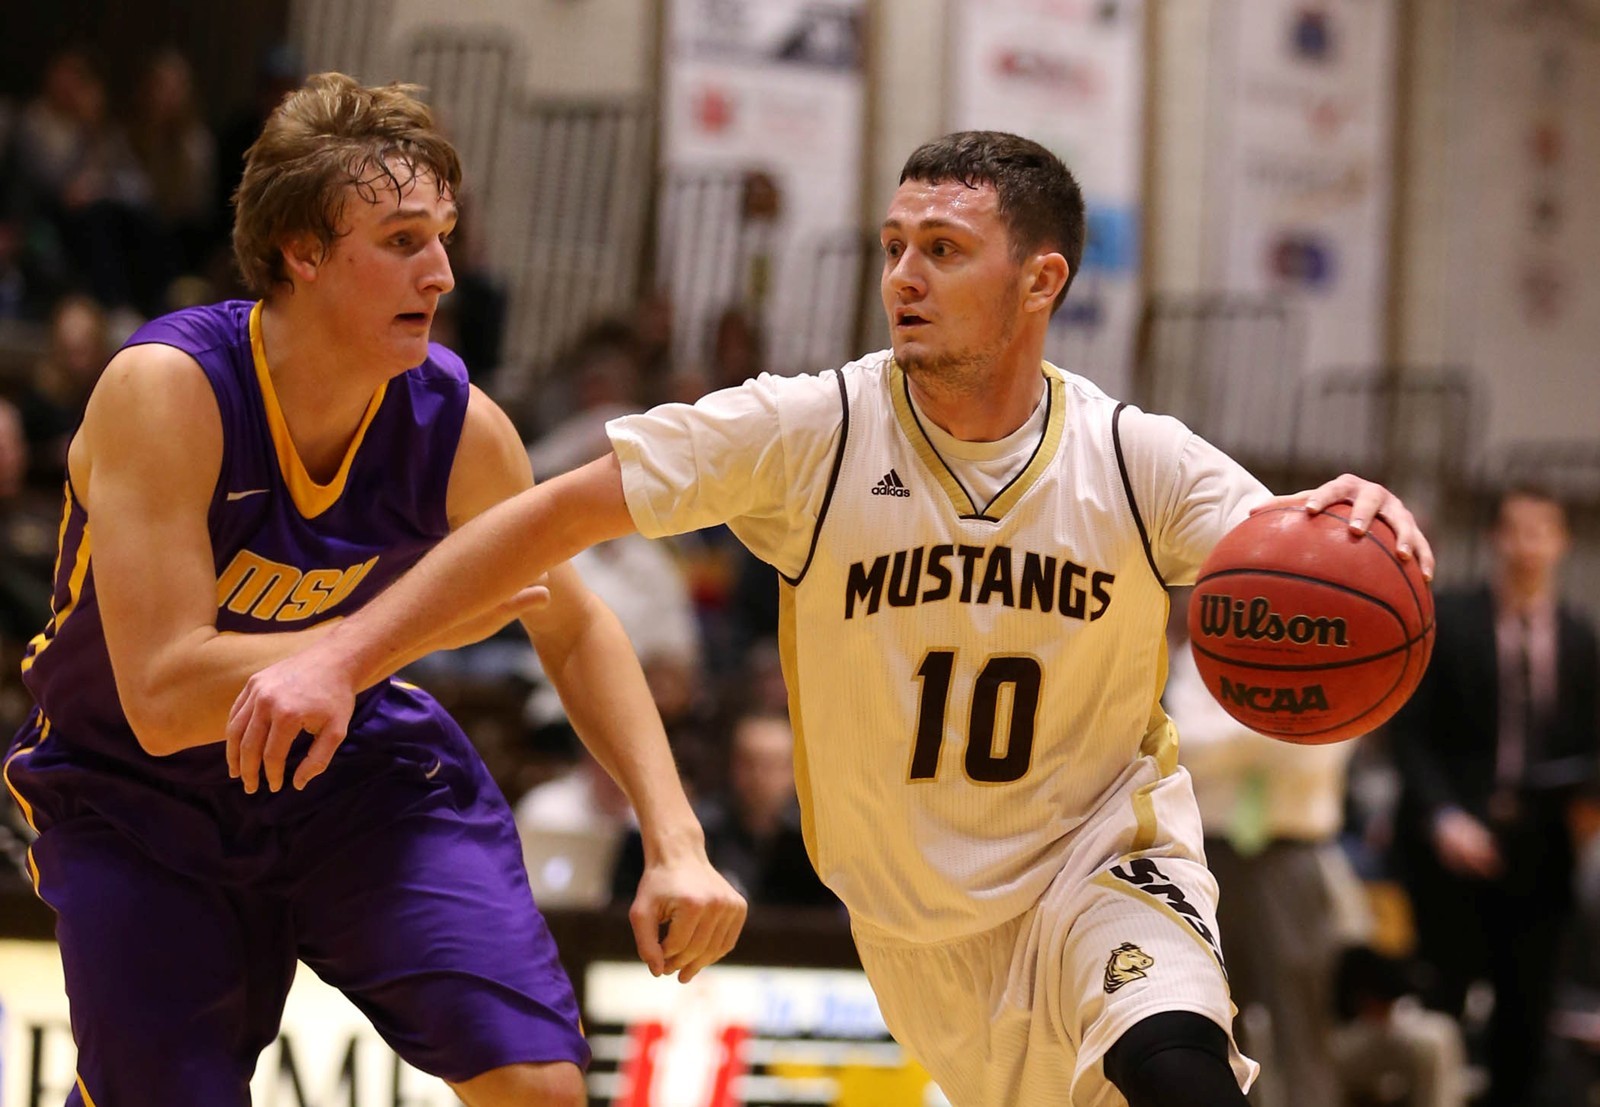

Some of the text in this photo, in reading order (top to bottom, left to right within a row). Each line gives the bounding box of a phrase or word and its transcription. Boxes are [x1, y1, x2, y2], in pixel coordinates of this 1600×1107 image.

[871, 485, 910, 497] adidas
[217, 549, 380, 621] MSU
[844, 544, 1115, 622] MUSTANGS
[1200, 594, 1348, 647] Wilson
[906, 646, 1044, 787] 10
[1219, 675, 1329, 714] NCAA
